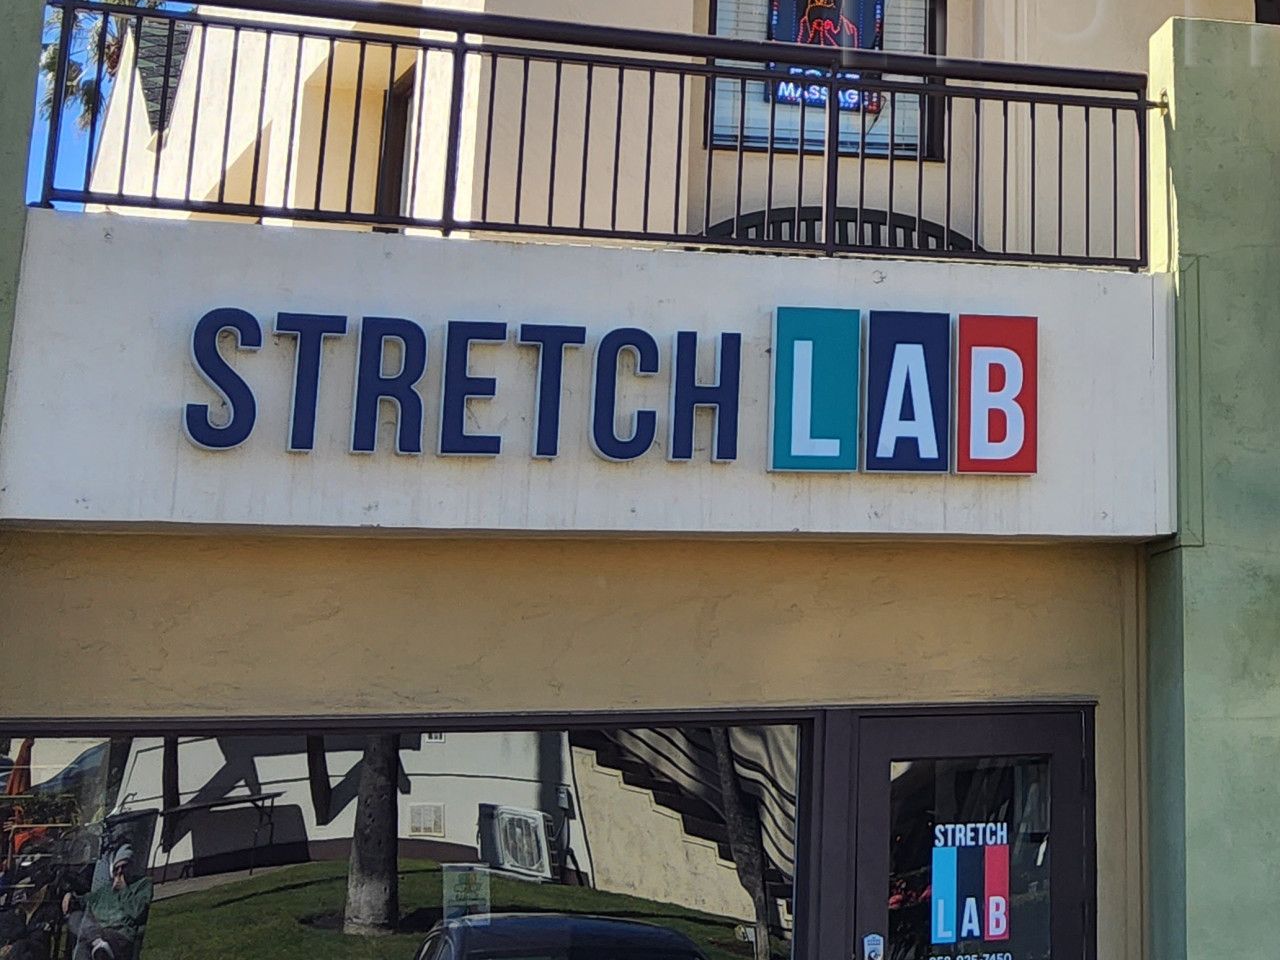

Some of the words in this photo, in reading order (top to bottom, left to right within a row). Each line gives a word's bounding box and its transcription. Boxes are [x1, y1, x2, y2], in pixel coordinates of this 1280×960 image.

[183, 307, 741, 464] STRETCH
[787, 336, 1028, 463] LAB
[935, 821, 1009, 847] STRETCH
[936, 895, 1008, 939] LAB
